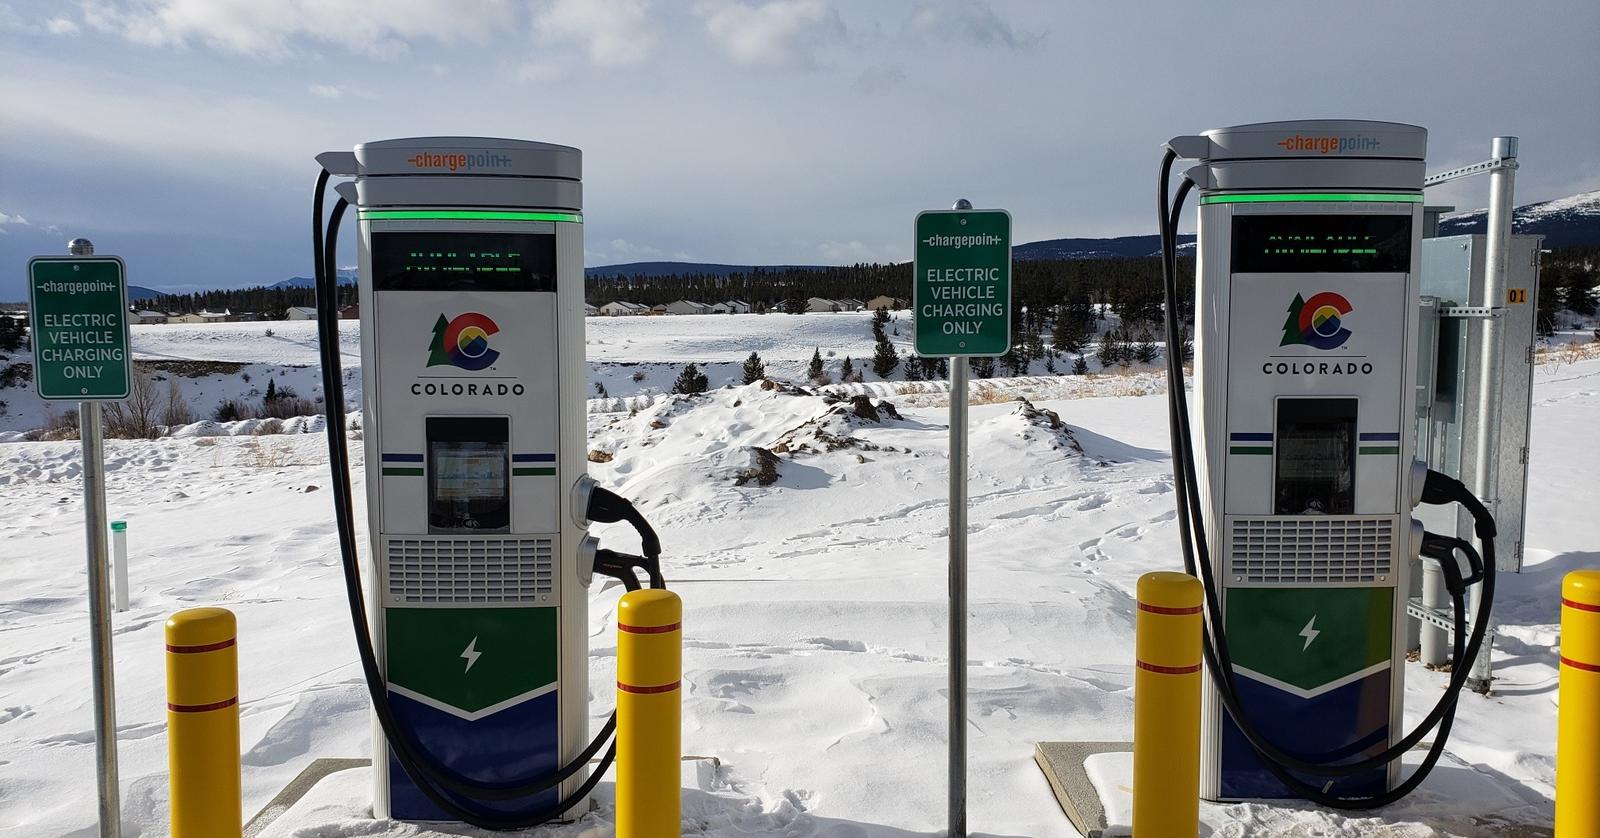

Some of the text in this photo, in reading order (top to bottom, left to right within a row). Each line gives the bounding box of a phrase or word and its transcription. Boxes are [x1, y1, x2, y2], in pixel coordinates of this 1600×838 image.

[927, 268, 999, 282] ELECTRIC
[931, 286, 995, 300] VEHICLE
[922, 303, 1003, 318] CHARGING
[44, 314, 117, 327] ELECTRIC
[942, 321, 983, 335] ONLY
[49, 331, 114, 344] VEHICLE
[42, 348, 123, 362] CHARGING
[63, 366, 103, 379] ONLY
[1262, 362, 1373, 375] COLORADO
[411, 383, 525, 396] COLORADO
